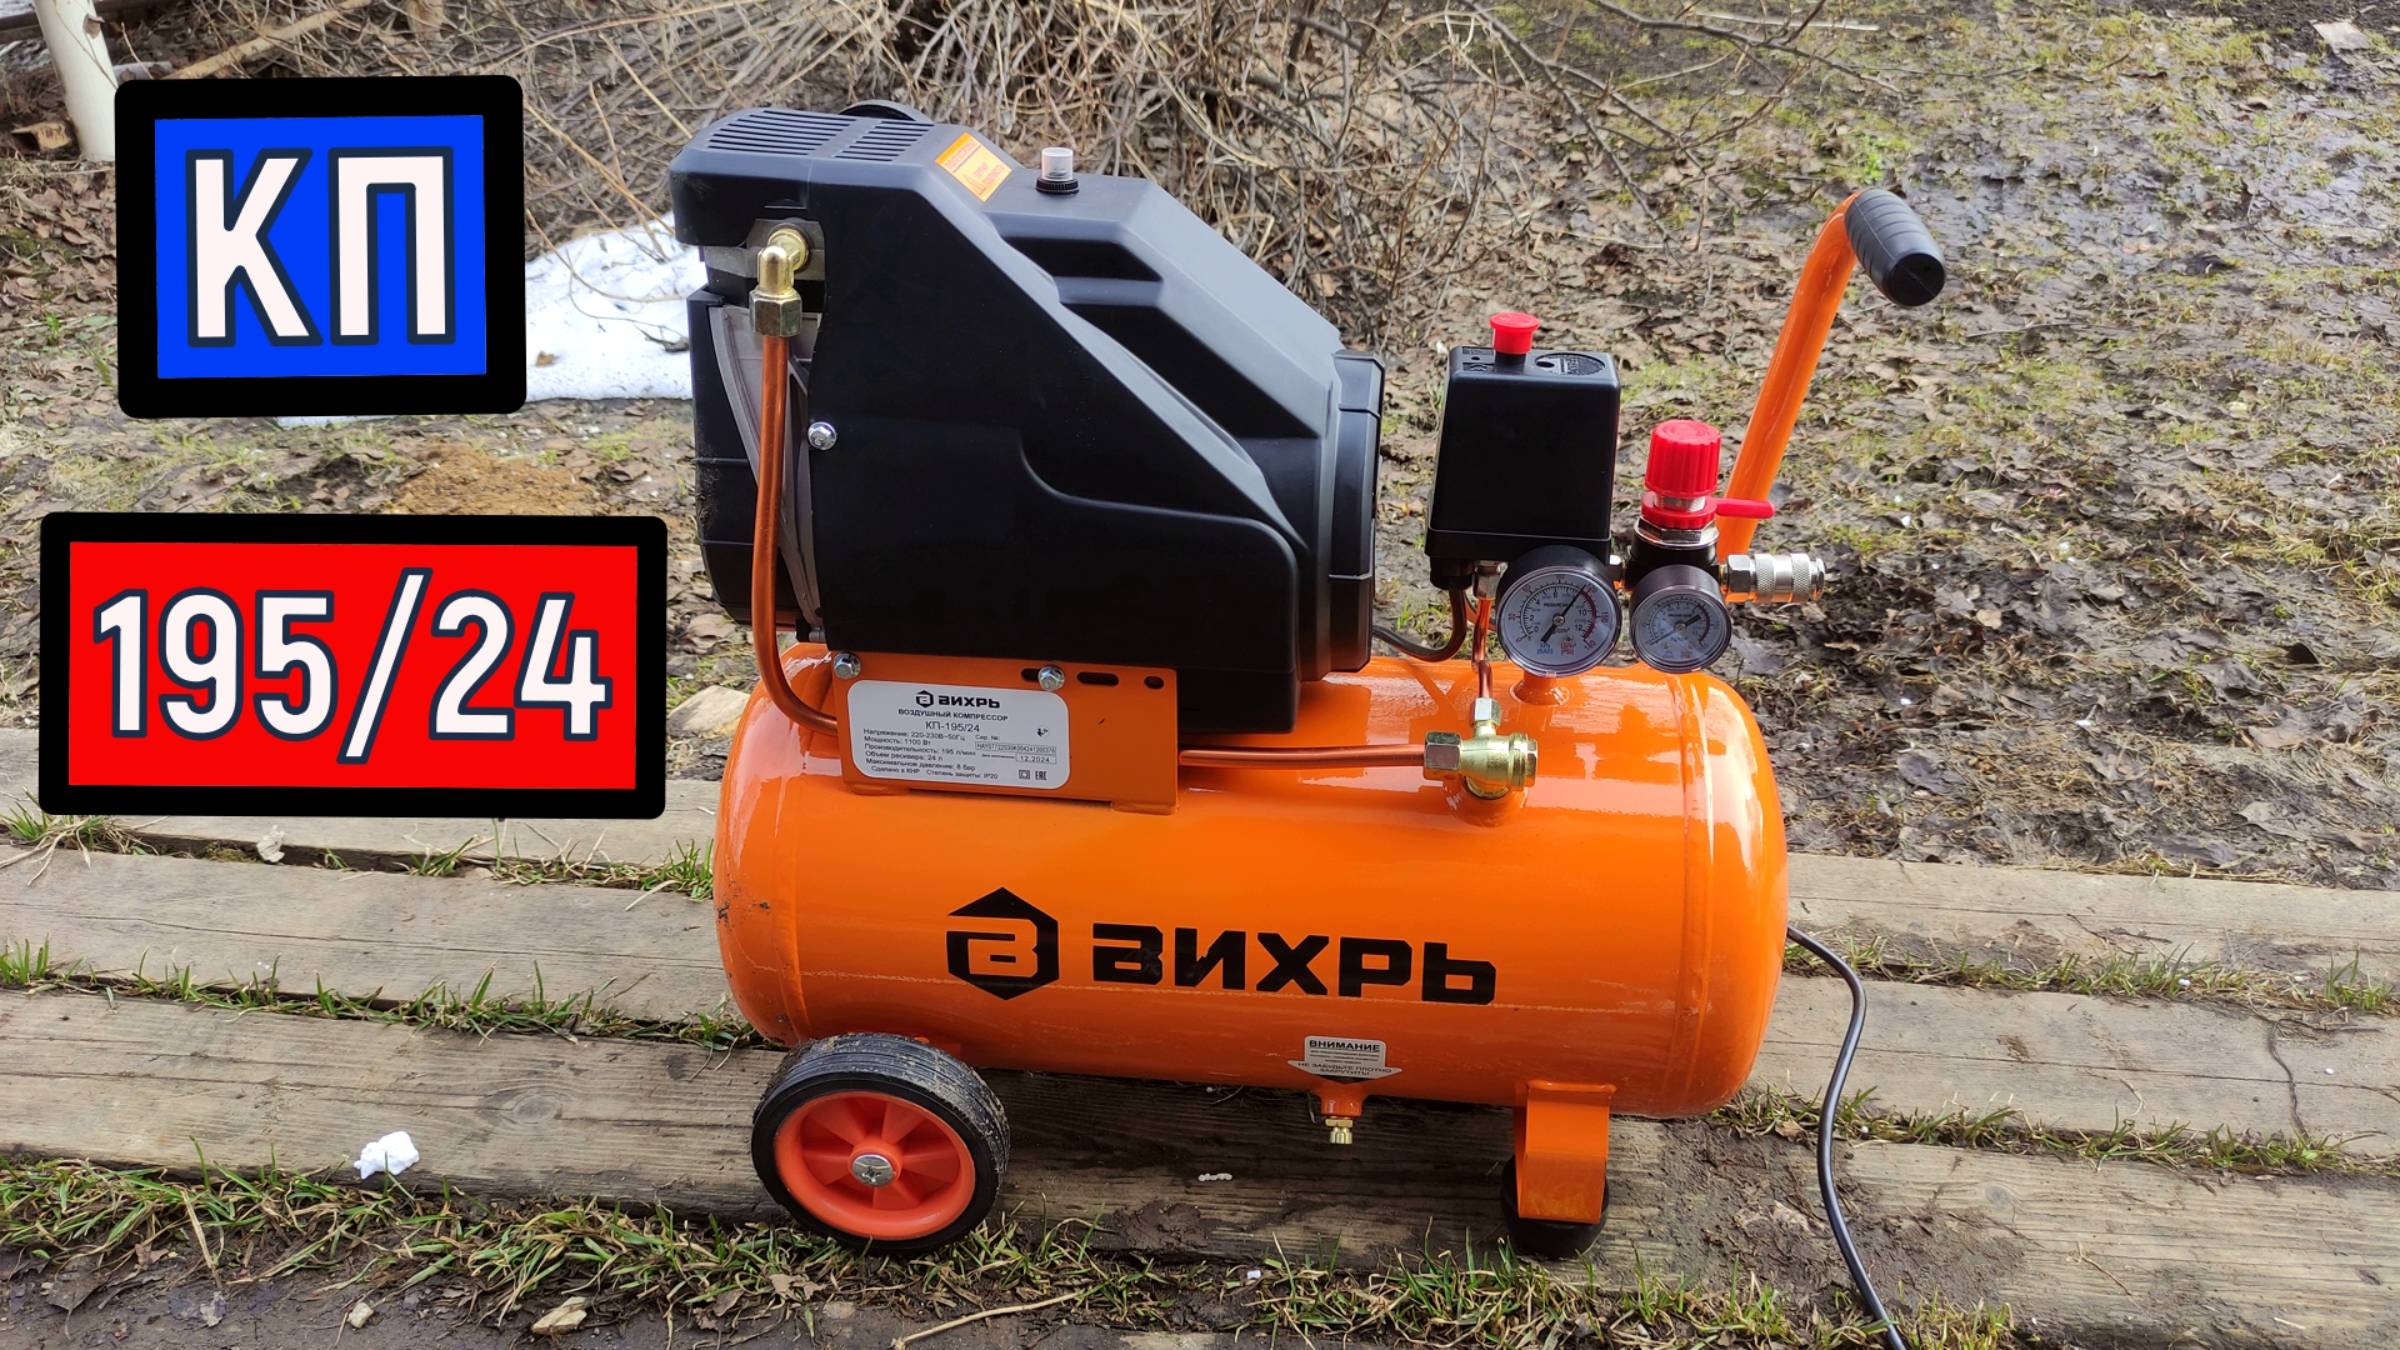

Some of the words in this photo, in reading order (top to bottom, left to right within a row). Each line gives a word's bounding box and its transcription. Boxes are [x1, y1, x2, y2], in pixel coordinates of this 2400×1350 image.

[938, 695, 1000, 709] ВИХРЬ
[898, 708, 951, 718] ВОЗДУШНЫЙ
[953, 712, 1008, 721] КОМПРЕССОР
[925, 721, 980, 733] КП-195/24
[1092, 922, 1497, 1006] ВИХРЬ
[1309, 1039, 1381, 1053] ВНИМАНИЕ
